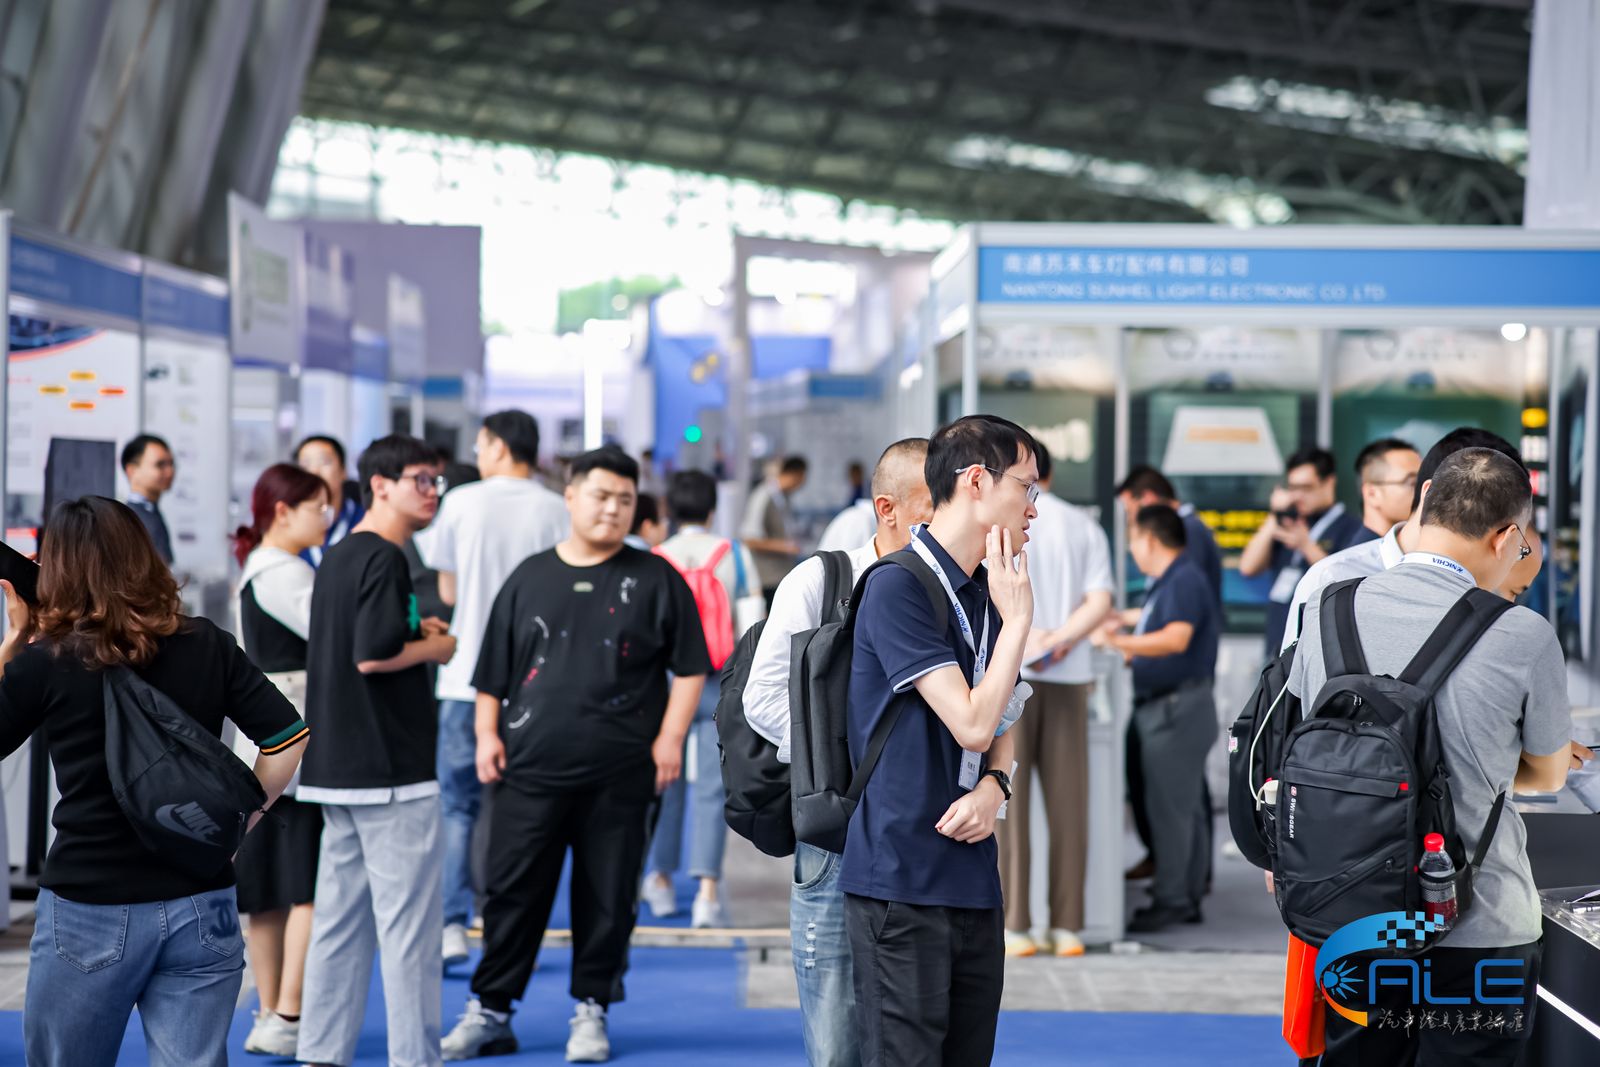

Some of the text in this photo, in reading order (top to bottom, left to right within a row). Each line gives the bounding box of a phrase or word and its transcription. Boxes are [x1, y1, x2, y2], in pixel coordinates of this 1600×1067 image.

[1001, 282, 1084, 299] NANTONG
[1156, 283, 1205, 299] LIGHT
[1209, 283, 1317, 299] ELECTRONIC
[1432, 557, 1457, 570] NICHIA
[174, 801, 221, 837] NIKE
